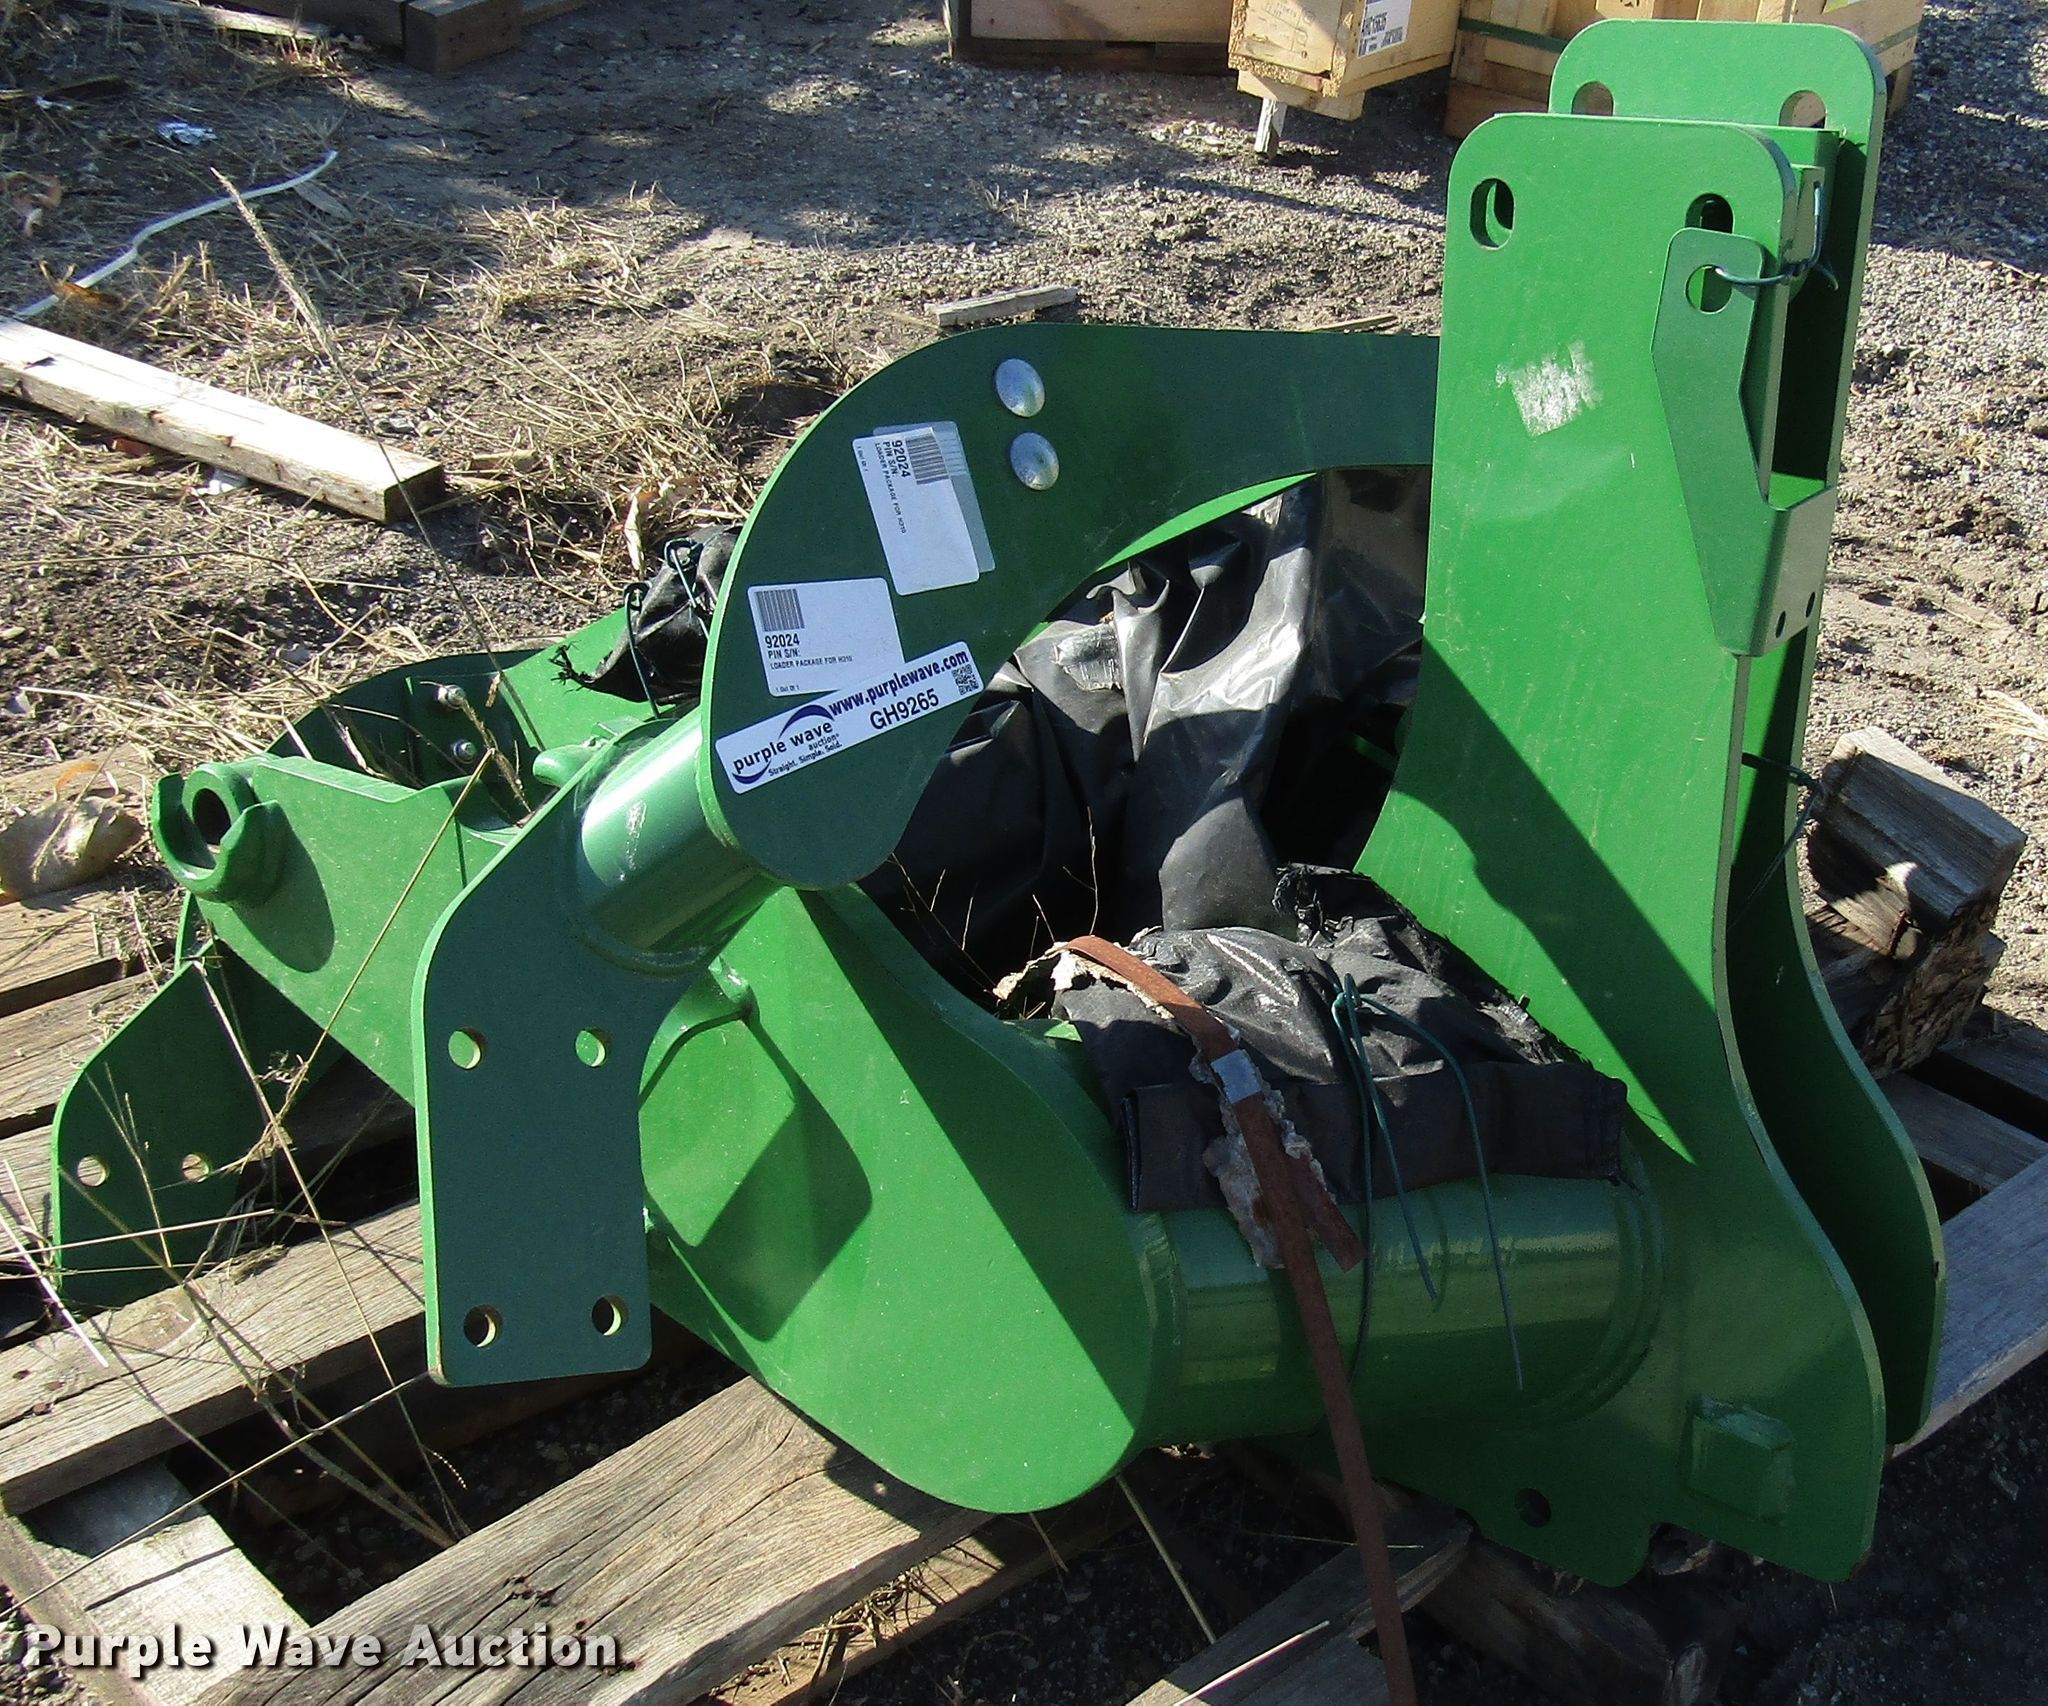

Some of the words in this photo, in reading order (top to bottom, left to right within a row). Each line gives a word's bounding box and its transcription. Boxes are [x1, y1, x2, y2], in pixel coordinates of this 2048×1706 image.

[883, 441, 893, 457] PIN
[892, 440, 911, 478] 92024
[875, 443, 888, 469] LOADER
[883, 470, 897, 501] PACKAGE
[893, 502, 902, 516] FOR
[764, 633, 800, 648] 92024
[768, 649, 782, 659] PIN
[784, 648, 801, 658] S/N:
[770, 662, 795, 670] LOADER
[796, 657, 823, 667] PACKAGE
[825, 656, 837, 664] FOR
[828, 650, 969, 716] www.purplewave.com
[869, 688, 939, 730] GH9265
[733, 741, 787, 774] purple
[790, 722, 833, 747] wave
[767, 759, 798, 776] Straight.
[798, 750, 825, 763] Simple.
[825, 741, 842, 753] Sold.
